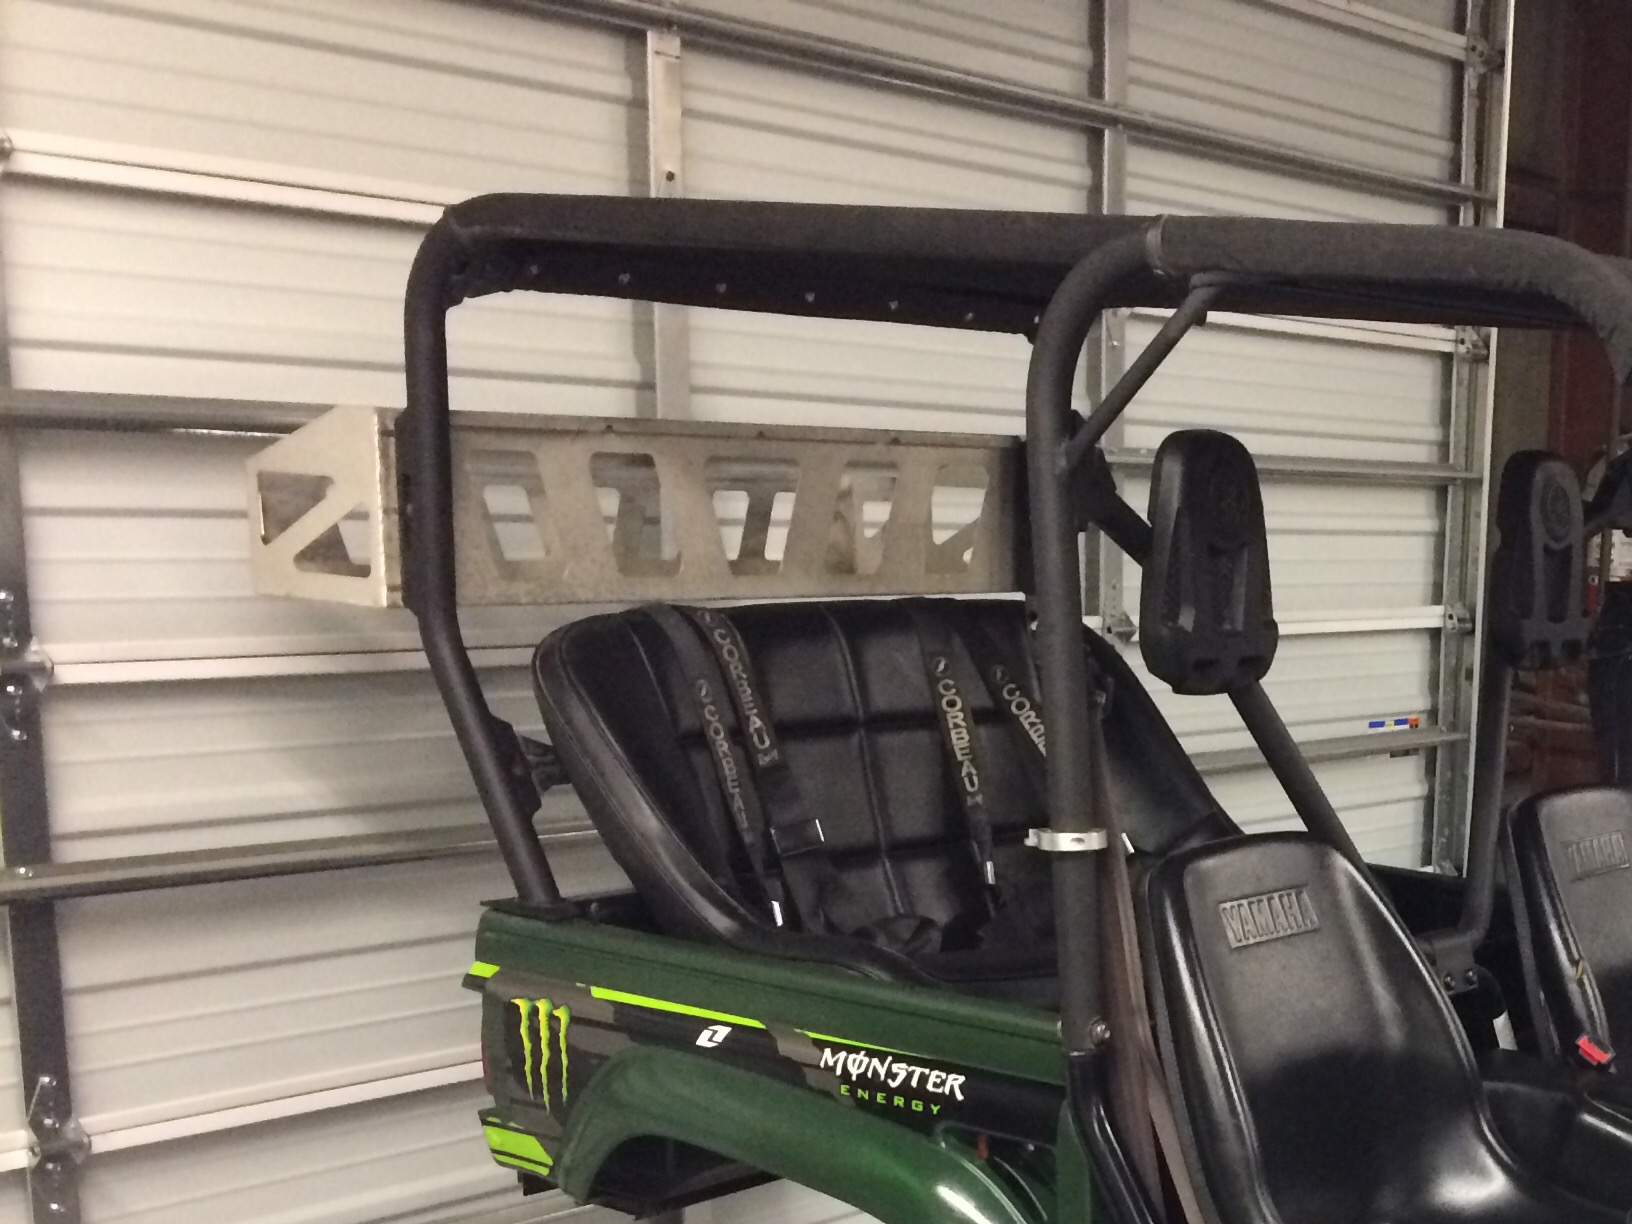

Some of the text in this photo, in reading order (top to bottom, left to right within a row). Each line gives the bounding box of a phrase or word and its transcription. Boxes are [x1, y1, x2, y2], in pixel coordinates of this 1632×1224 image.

[713, 628, 770, 749] CORBEAU
[937, 679, 979, 792] CORBEAU
[1221, 889, 1318, 943] YAMAHA
[840, 1084, 941, 1115] ENERGY
